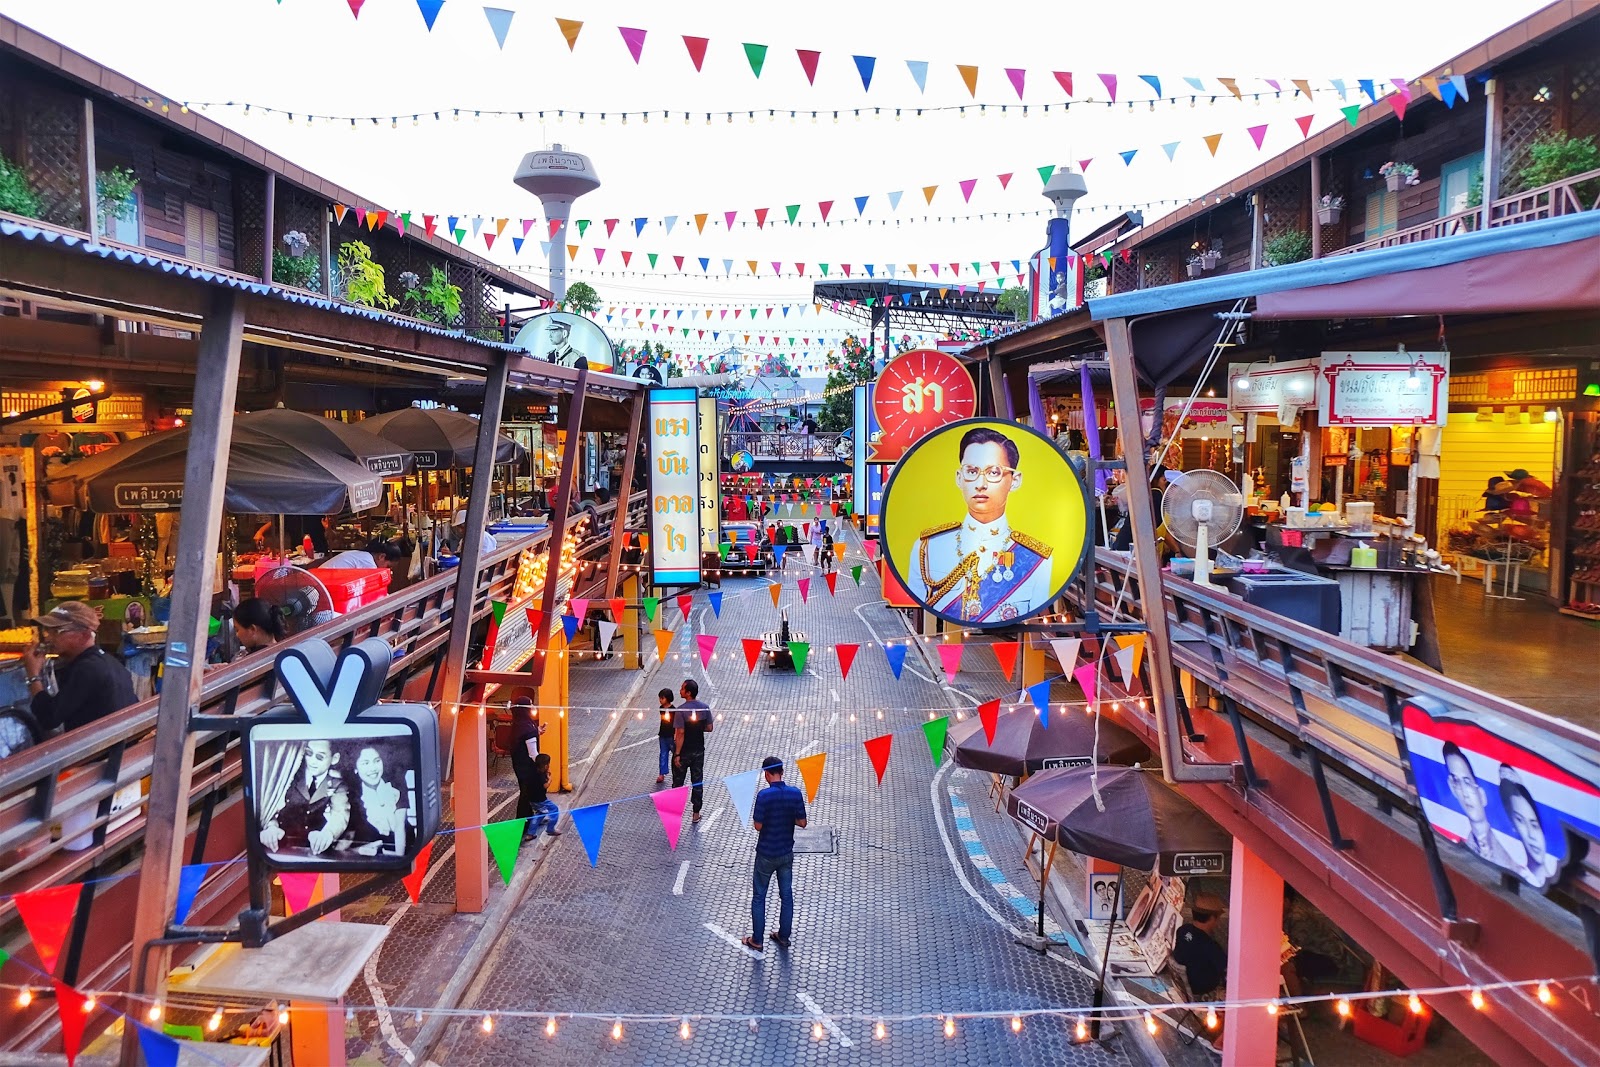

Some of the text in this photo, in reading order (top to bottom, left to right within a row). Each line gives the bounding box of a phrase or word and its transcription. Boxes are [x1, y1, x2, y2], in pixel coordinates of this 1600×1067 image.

[901, 376, 944, 415] สา
[655, 417, 690, 437] แรง
[657, 449, 690, 476] บัน
[654, 494, 694, 515] ดาล
[663, 523, 688, 553] ใจ
[1179, 856, 1218, 867] เพลินวาน
